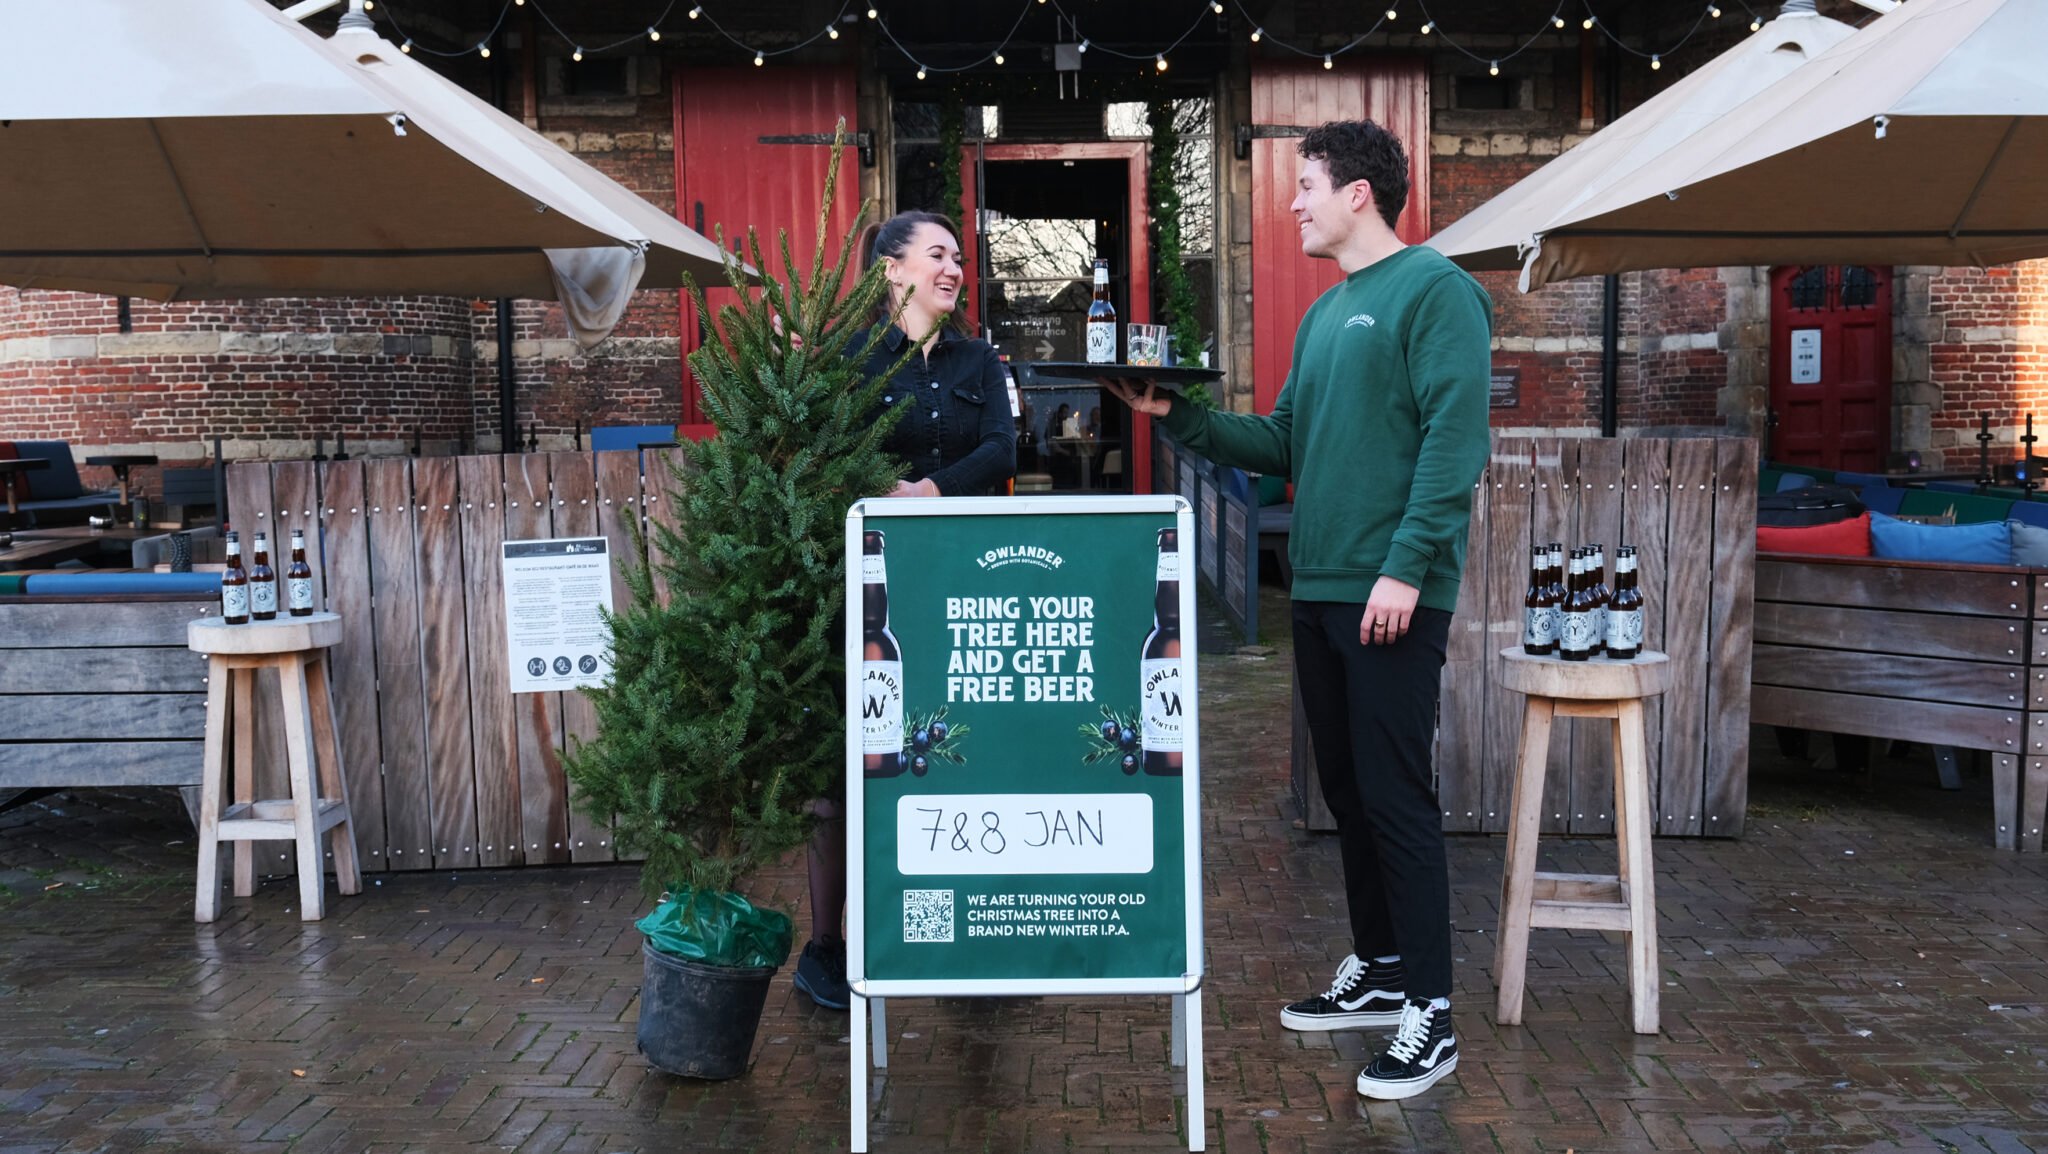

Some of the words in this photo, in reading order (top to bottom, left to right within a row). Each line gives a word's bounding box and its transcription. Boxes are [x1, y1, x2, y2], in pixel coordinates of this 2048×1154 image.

[976, 545, 1063, 568] LOWLANDER
[947, 597, 1020, 619] BRING
[1029, 597, 1094, 619] YOUR
[948, 623, 1016, 647] TREE
[1026, 622, 1094, 646] HERE
[948, 650, 1003, 673] AND
[1013, 650, 1066, 673] GET
[1077, 650, 1094, 673] A
[948, 676, 1014, 702] FREE
[1025, 676, 1094, 702] BEER
[1145, 668, 1181, 699] LOWLA
[917, 808, 1006, 854] 7&8
[1024, 810, 1103, 846] JAN
[968, 895, 986, 905] WE
[990, 895, 1015, 905] ARE
[1018, 894, 1077, 905] TURNING
[1080, 894, 1115, 905] YOUR
[1119, 894, 1145, 905] OLD
[968, 910, 1040, 921] CHRISTMAS
[1043, 910, 1074, 921] TREE
[1078, 910, 1108, 920] INTO
[1111, 910, 1120, 920] A
[968, 925, 1013, 936] BRAND
[1017, 925, 1046, 936] NEW
[1049, 925, 1097, 936] WINTER
[1101, 925, 1130, 936] I.P.A.
